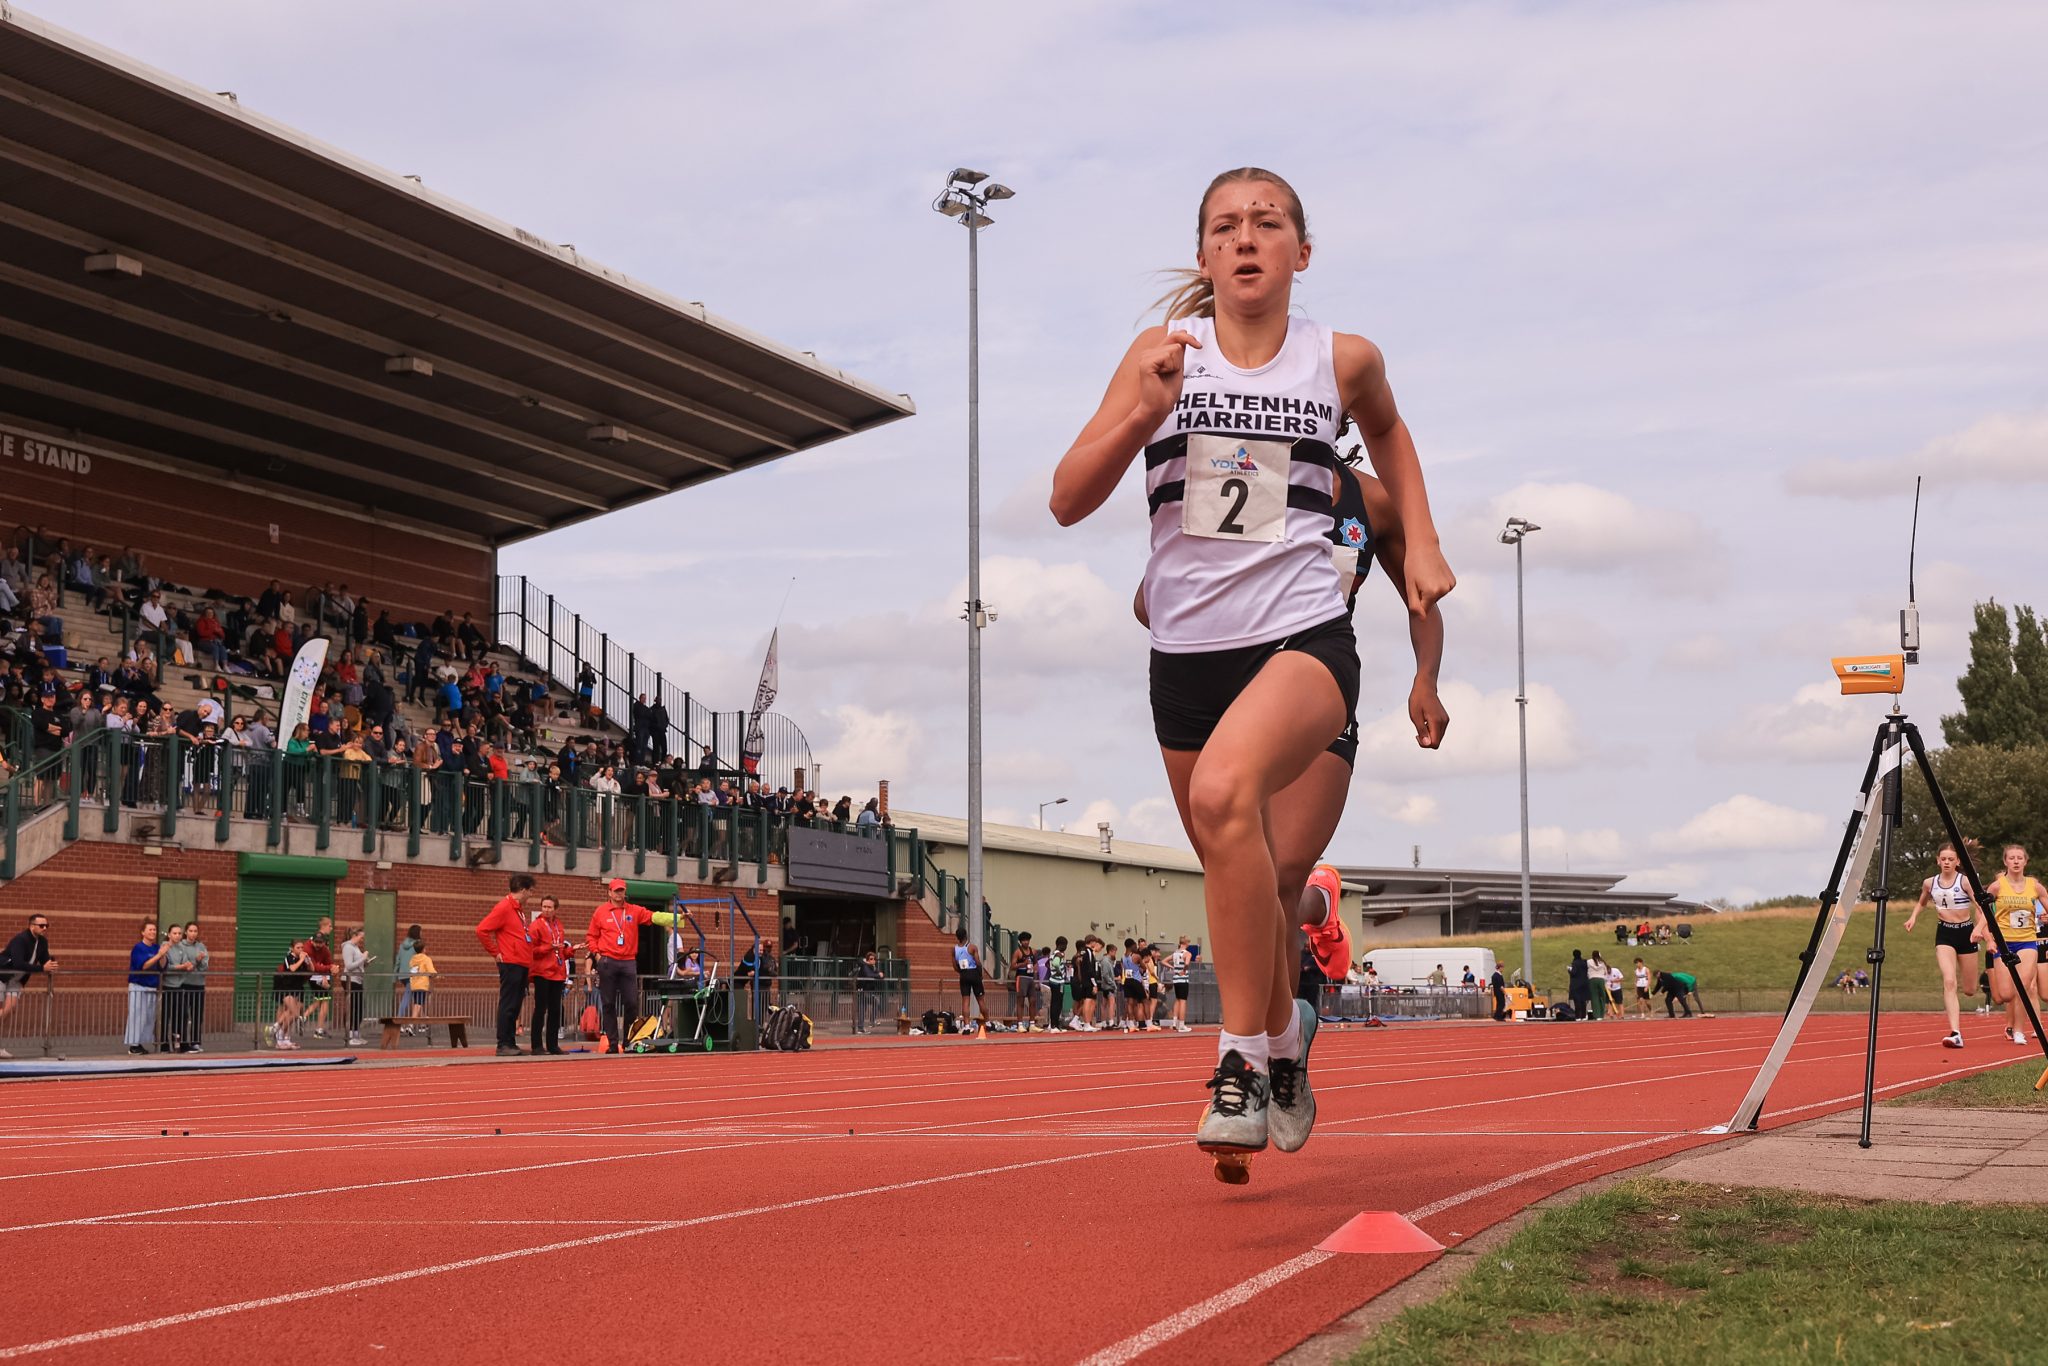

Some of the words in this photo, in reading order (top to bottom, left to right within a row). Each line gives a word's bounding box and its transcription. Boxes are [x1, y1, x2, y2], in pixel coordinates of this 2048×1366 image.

[1176, 393, 1332, 422] HELTENHAM
[1177, 411, 1318, 435] HARRIERS
[23, 440, 91, 474] STAND
[1211, 459, 1238, 469] YDL
[1217, 478, 1248, 534] 2
[2018, 918, 2023, 927] 5
